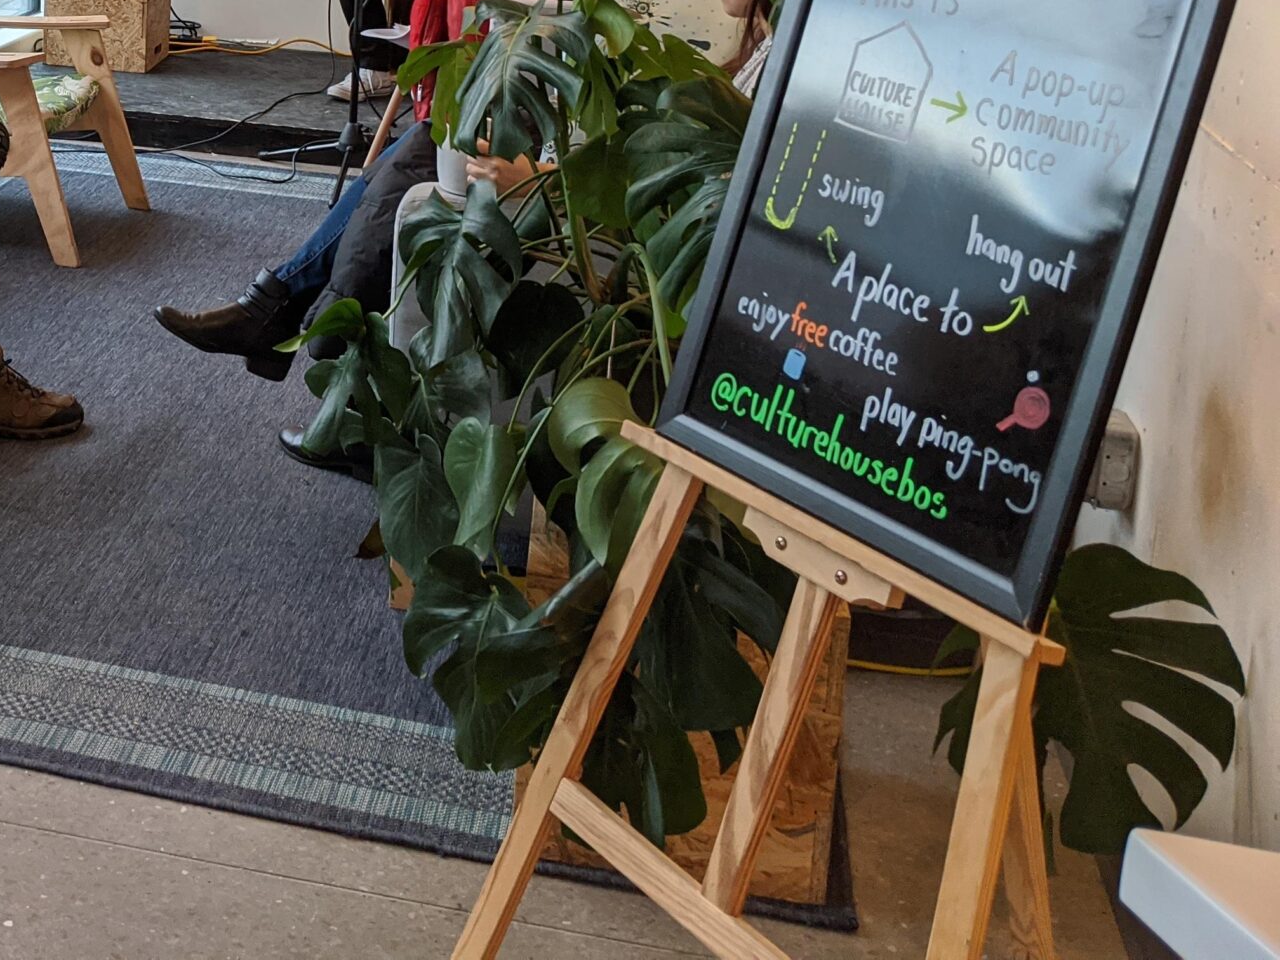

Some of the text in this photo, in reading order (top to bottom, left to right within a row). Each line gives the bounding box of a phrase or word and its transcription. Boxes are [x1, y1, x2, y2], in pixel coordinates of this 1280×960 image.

[844, 97, 906, 132] HOUSE
[849, 70, 916, 108] CULTURE
[990, 49, 1125, 124] A pop-up
[818, 173, 886, 227] swing
[831, 251, 974, 337] A place to
[966, 214, 1078, 294] hang out
[738, 292, 899, 376] enjoy free coffee
[711, 372, 948, 520] @culturehousebos
[860, 387, 1043, 515] play ping-pong
